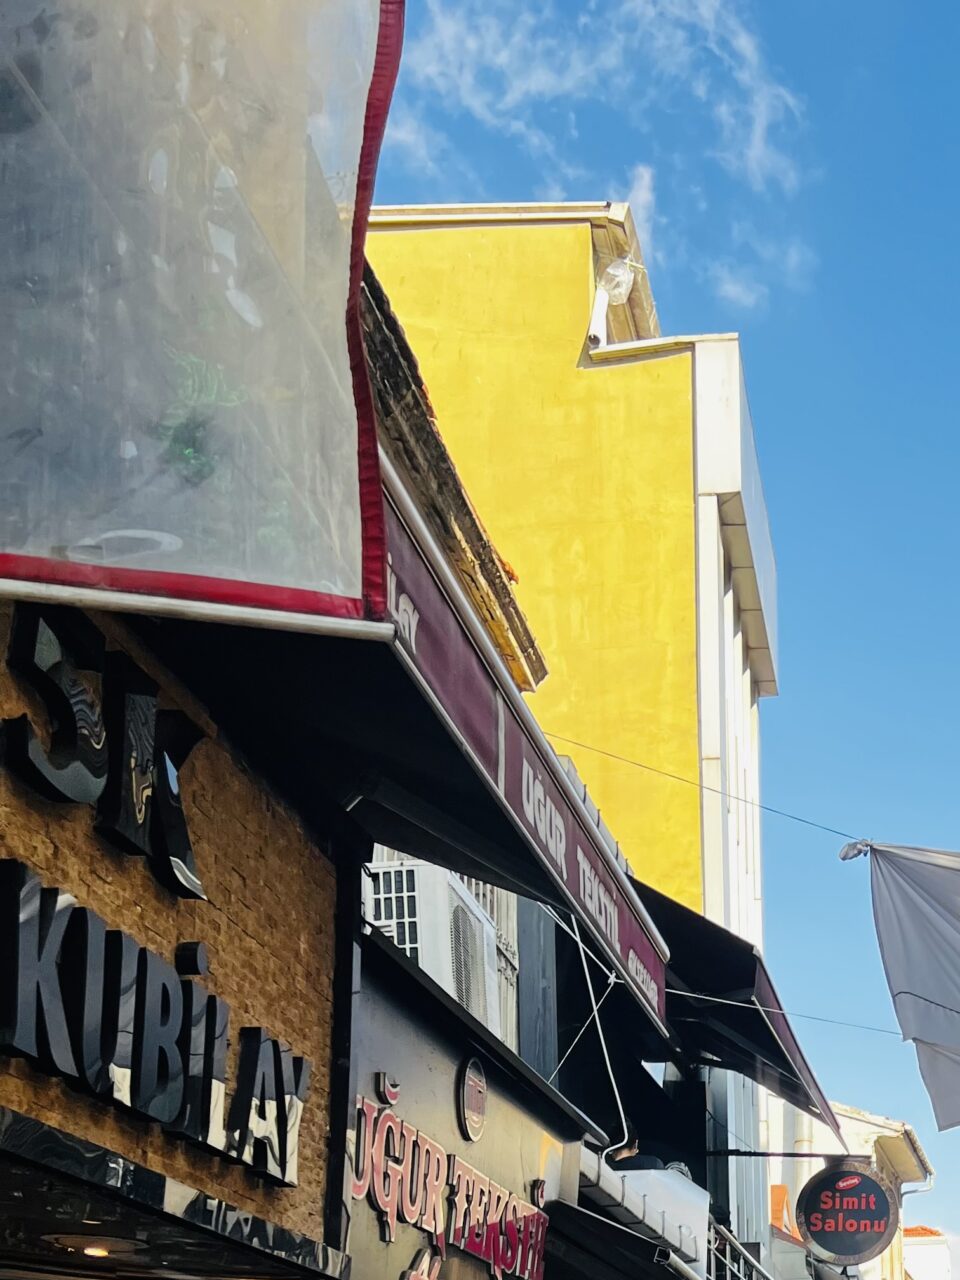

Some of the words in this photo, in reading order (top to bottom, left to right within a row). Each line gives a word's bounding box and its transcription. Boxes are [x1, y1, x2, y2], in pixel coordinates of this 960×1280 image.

[521, 756, 568, 883] UĞUR
[576, 844, 621, 956] TEKSTİL
[350, 1068, 447, 1262] UĞUR
[820, 1191, 876, 1211] Simit
[809, 1212, 888, 1233] Salonu
